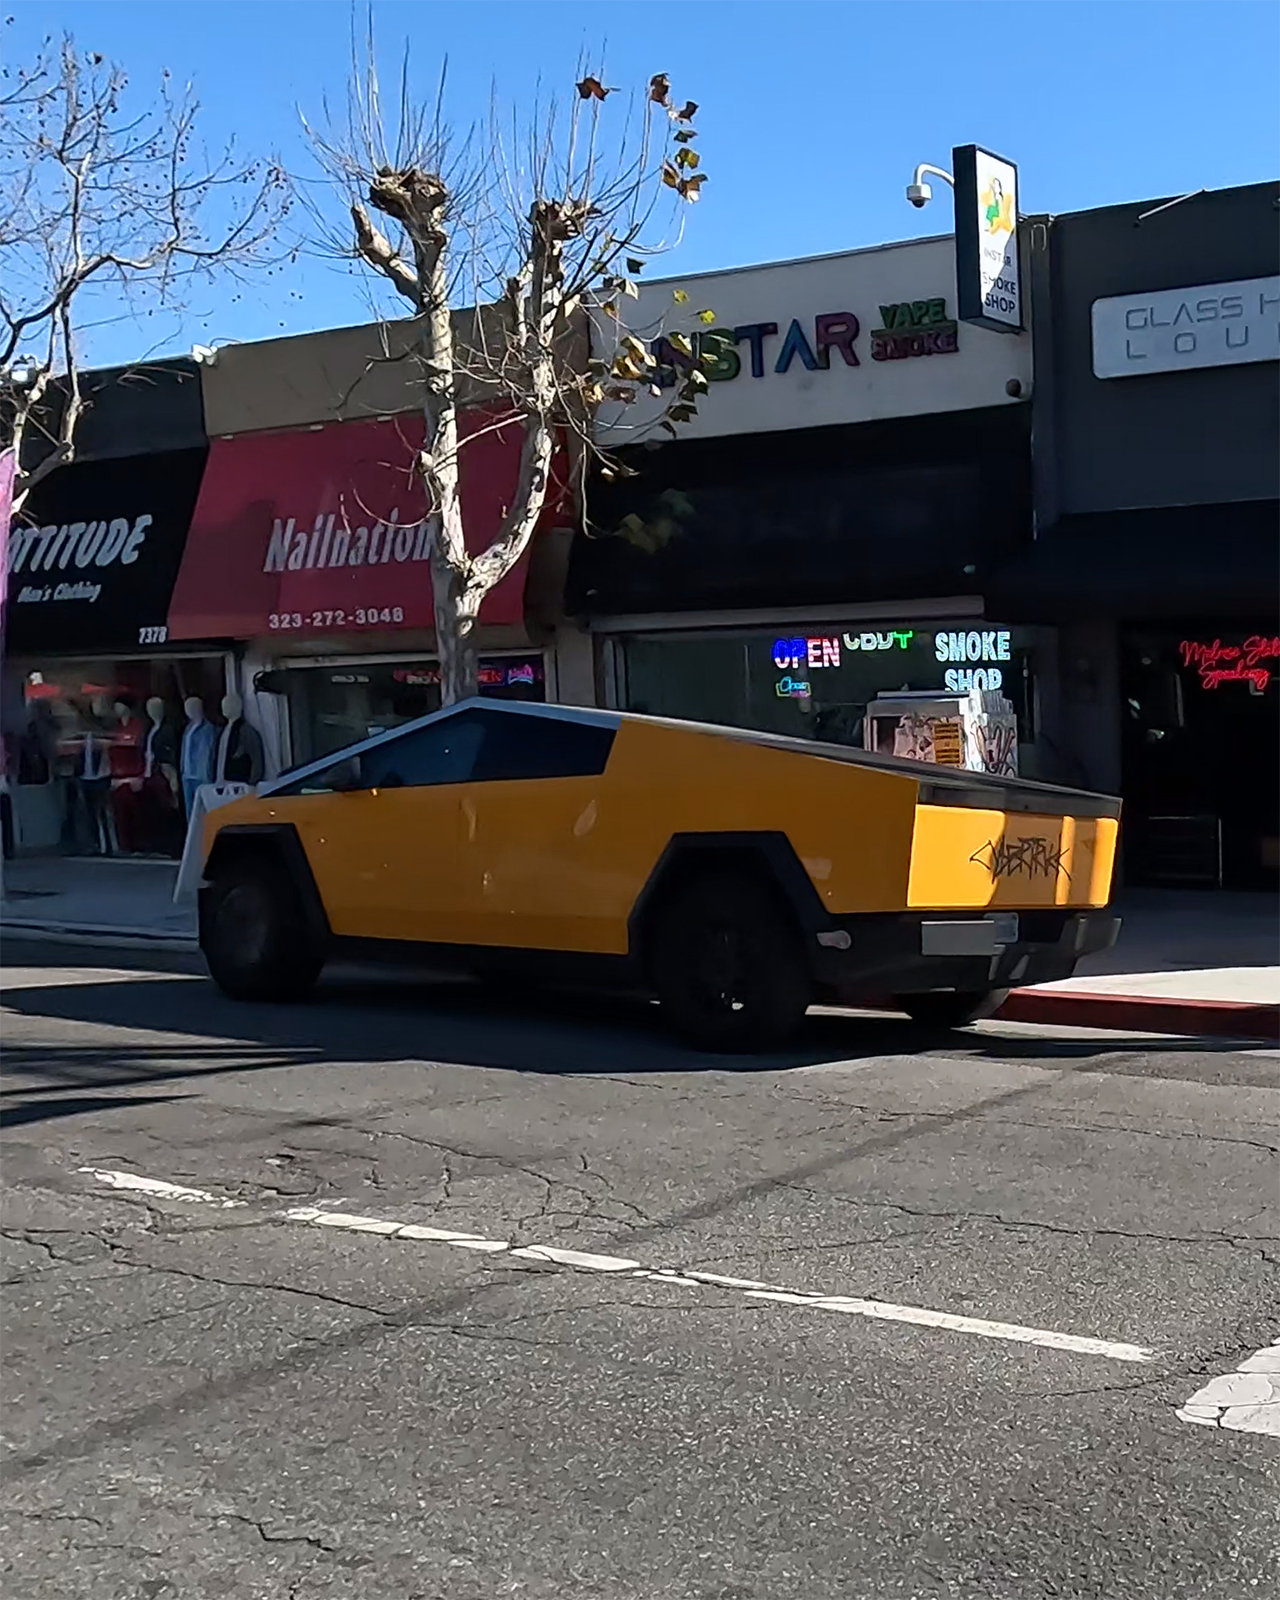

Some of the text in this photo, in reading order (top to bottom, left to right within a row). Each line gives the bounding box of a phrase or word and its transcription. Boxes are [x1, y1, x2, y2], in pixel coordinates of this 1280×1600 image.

[983, 272, 1016, 296] SMOKE
[879, 298, 946, 329] VAPE
[985, 292, 1016, 314] SHOP
[1126, 296, 1243, 330] GLASS
[649, 311, 861, 388] NSTAR
[871, 331, 959, 361] SMOKE
[1126, 323, 1280, 360] LOU
[263, 507, 435, 572] Nailnation
[269, 607, 404, 629] 323-272-3048
[138, 626, 167, 644] 7378
[935, 631, 1011, 662] SMOKE
[772, 637, 841, 669] OPEN
[944, 668, 1003, 692] SHOP
